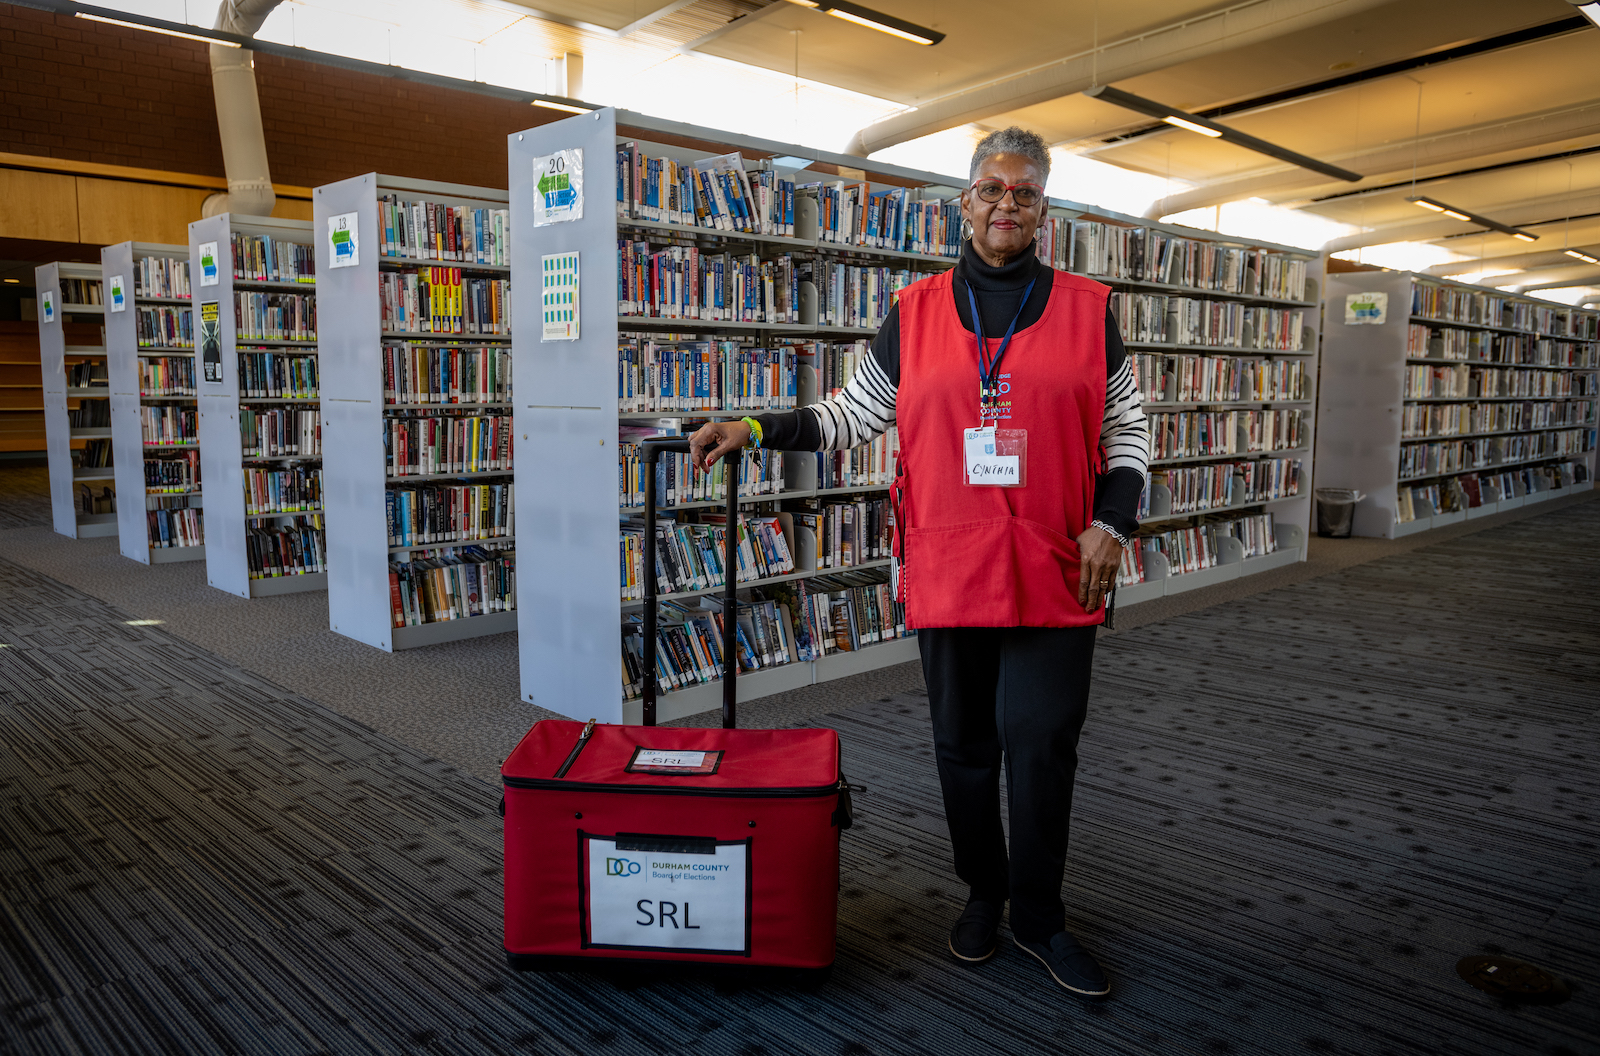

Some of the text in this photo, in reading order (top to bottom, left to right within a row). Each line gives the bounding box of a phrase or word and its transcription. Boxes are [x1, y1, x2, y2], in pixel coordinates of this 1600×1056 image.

[550, 156, 564, 174] 20
[704, 181, 714, 203] Greece
[339, 217, 346, 230] 13
[871, 205, 879, 230] BRAZIL
[972, 463, 1015, 477] CYNTHIA
[739, 629, 752, 654] California
[652, 862, 690, 870] DURHAM
[652, 871, 672, 879] Board
[636, 899, 700, 929] SRL
